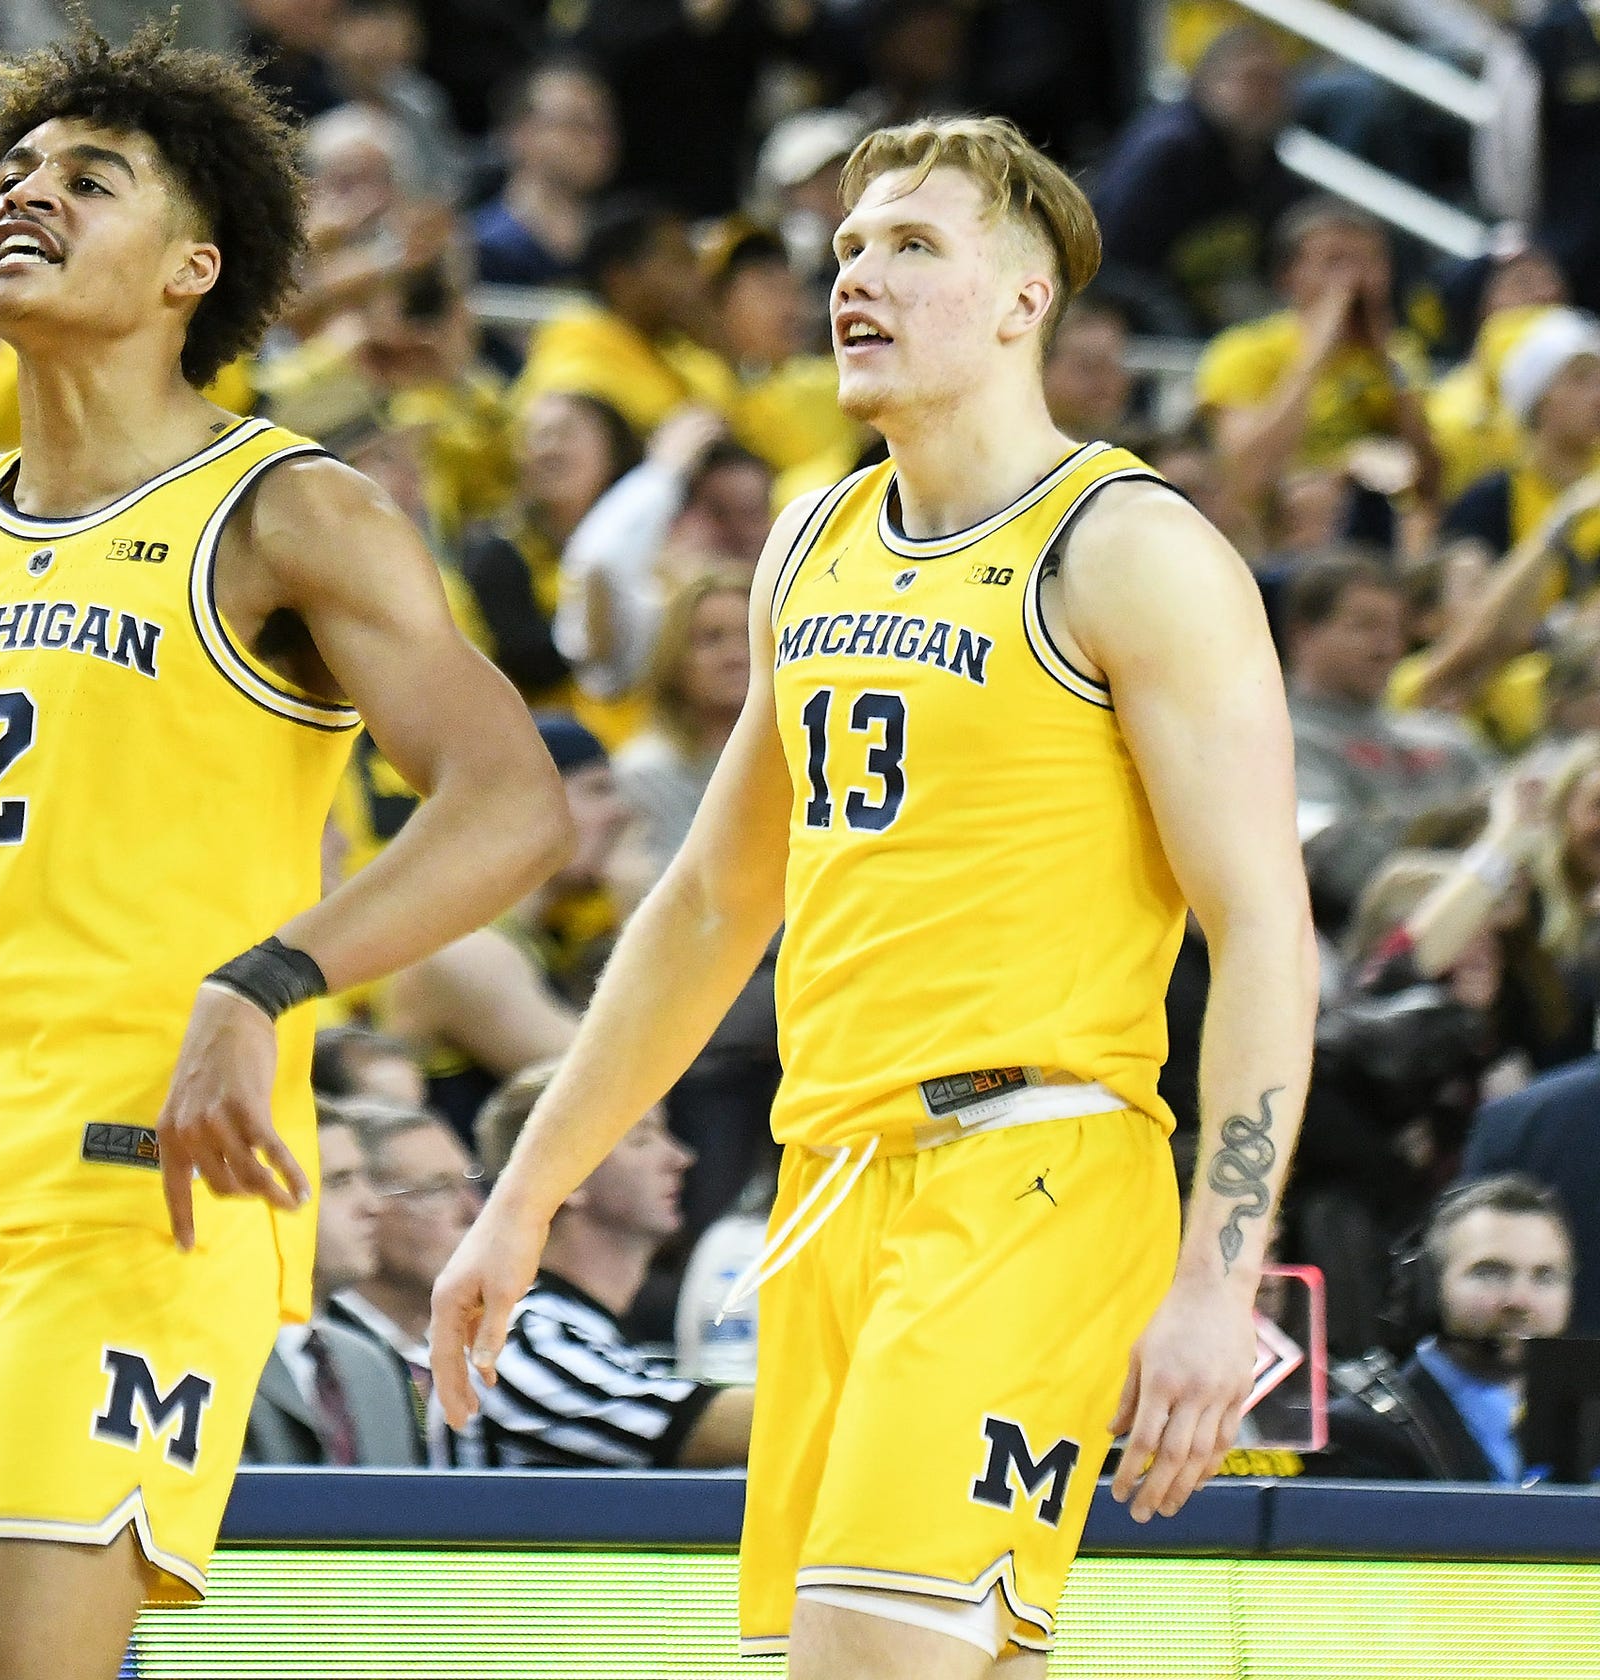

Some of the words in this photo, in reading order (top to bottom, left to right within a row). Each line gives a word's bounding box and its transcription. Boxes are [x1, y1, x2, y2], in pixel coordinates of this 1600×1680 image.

[775, 613, 994, 686] MICHIGAN
[802, 687, 908, 834] 13
[90, 1344, 215, 1476] M
[969, 1412, 1082, 1531] M
